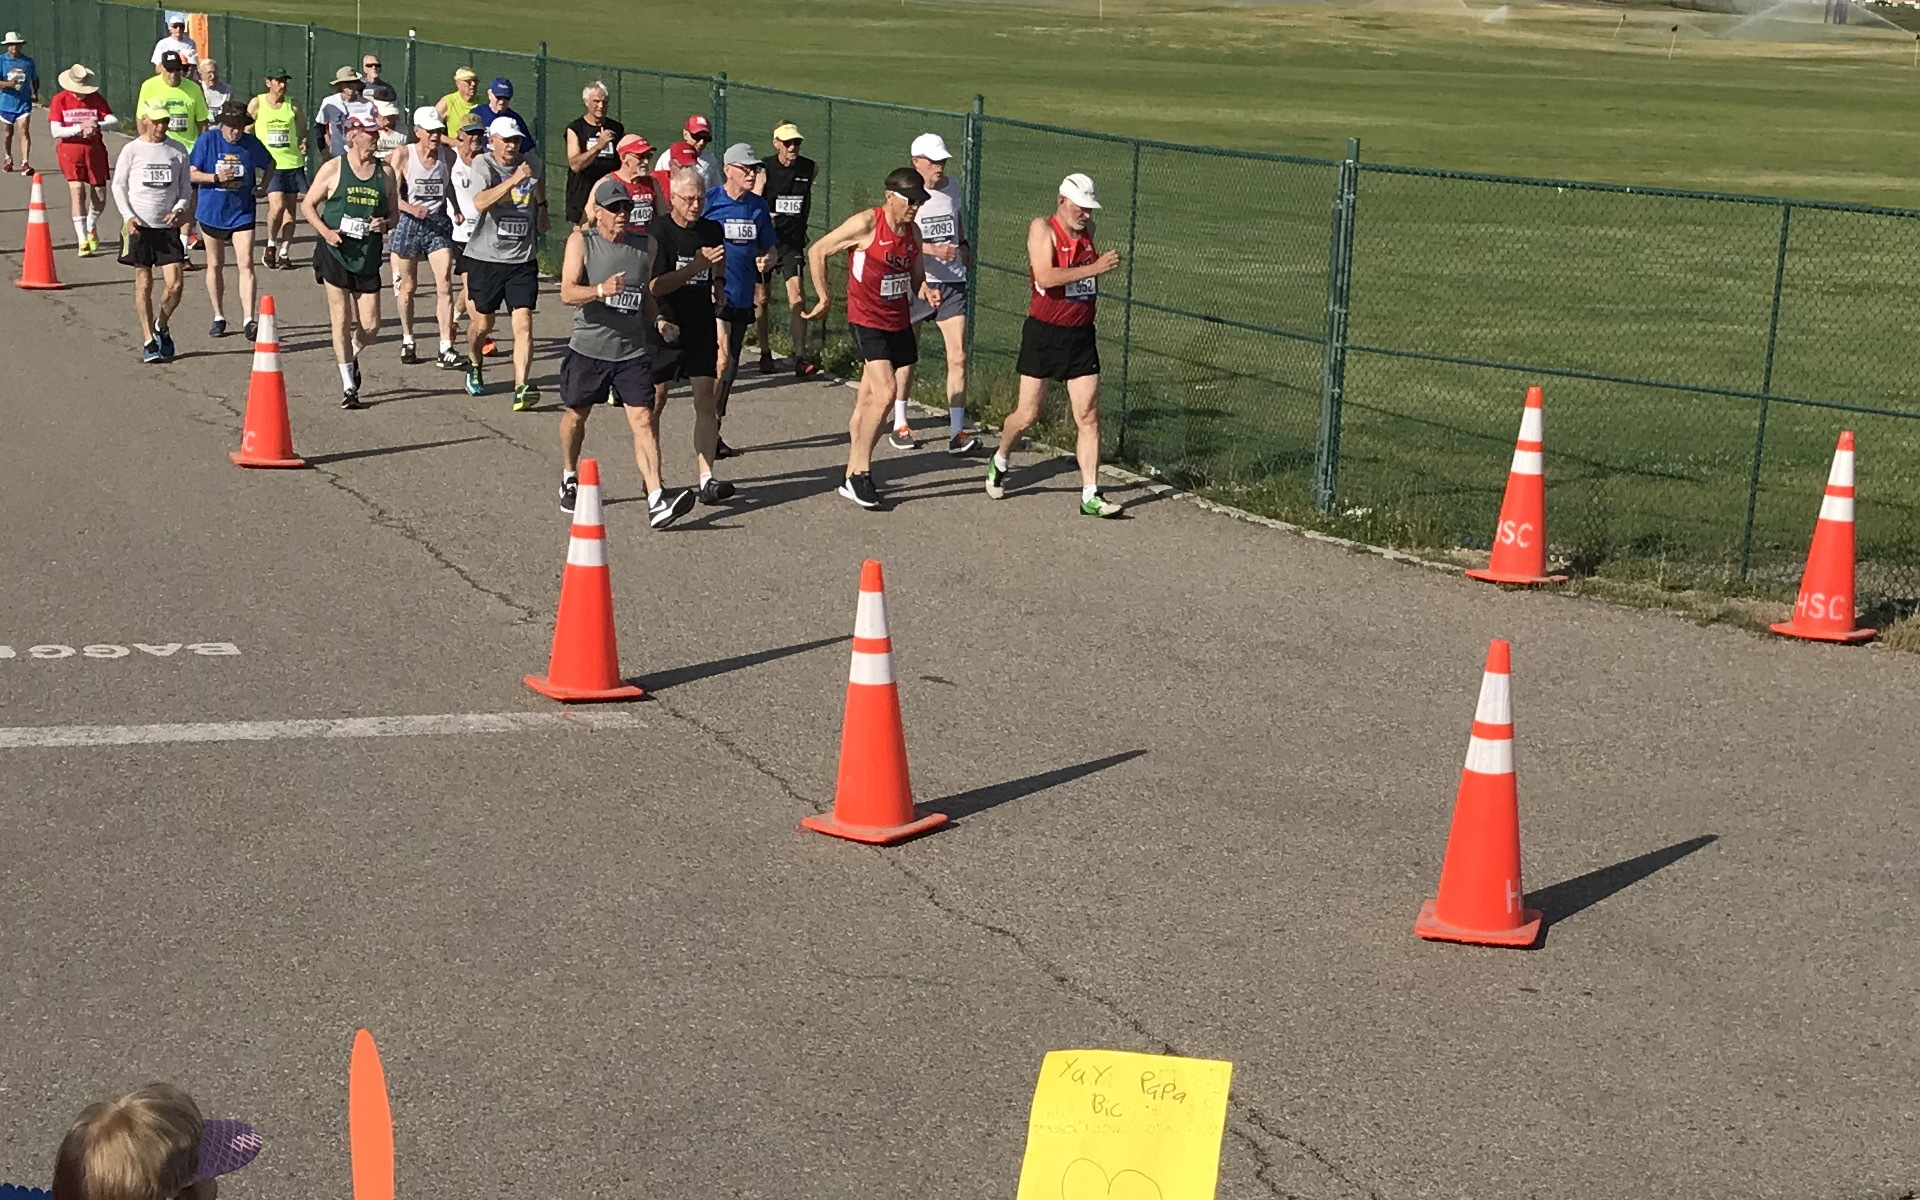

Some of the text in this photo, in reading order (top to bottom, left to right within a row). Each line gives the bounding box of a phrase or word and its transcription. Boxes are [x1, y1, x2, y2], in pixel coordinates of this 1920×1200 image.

[151, 170, 170, 181] 1351
[424, 185, 440, 195] 550
[508, 223, 527, 235] 1137
[737, 225, 753, 238] 156
[930, 222, 953, 236] 2093
[616, 293, 639, 308] 1074
[1798, 591, 1845, 620] HSC
[0, 642, 242, 659] BAGG
